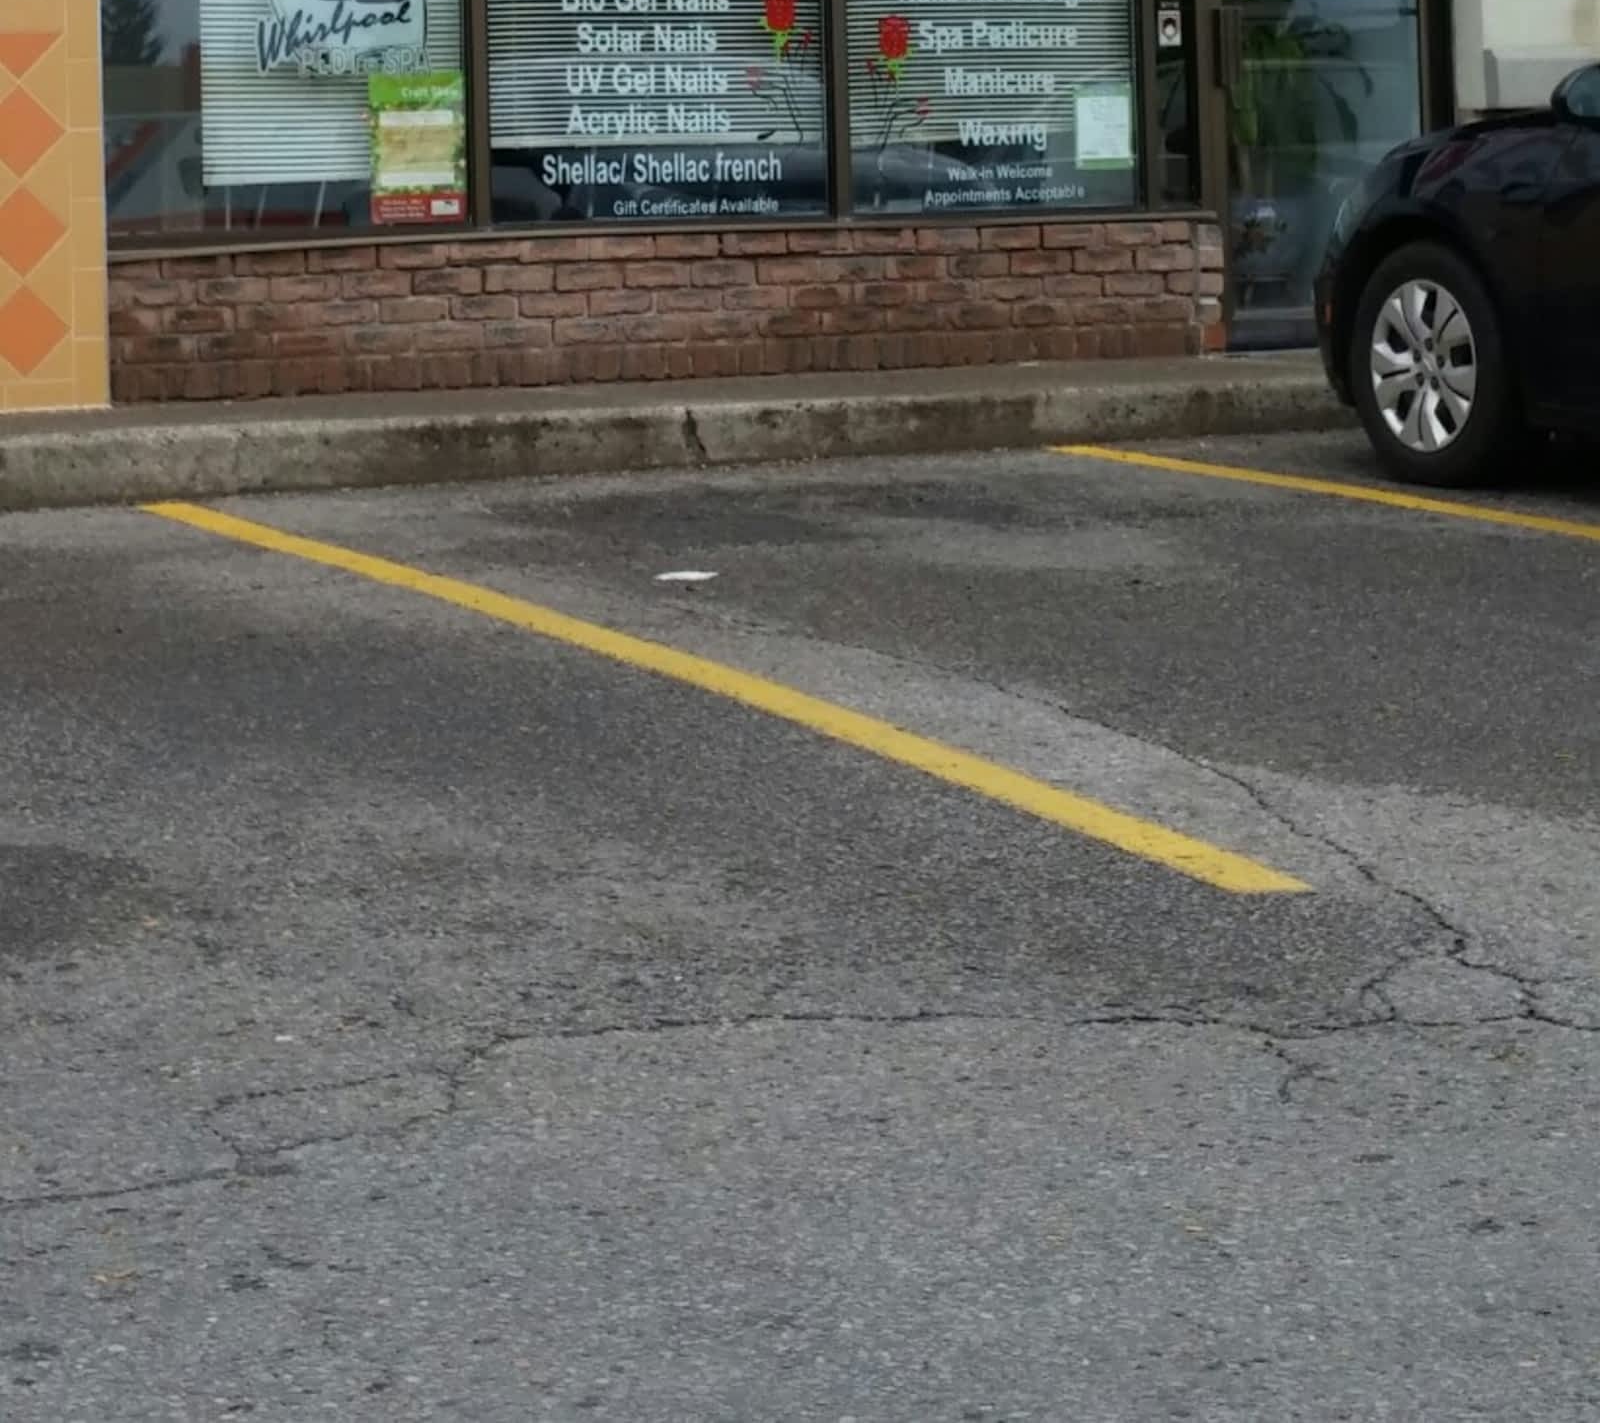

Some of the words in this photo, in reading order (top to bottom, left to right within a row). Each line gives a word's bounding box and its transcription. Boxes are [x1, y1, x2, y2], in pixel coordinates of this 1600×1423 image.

[258, 0, 412, 72] Whirlpool
[577, 23, 643, 53] Solar
[653, 23, 718, 52] Nails
[919, 21, 963, 54] Spa
[972, 21, 1078, 49] Pedicure
[565, 65, 604, 94] UV
[611, 65, 655, 94] Gel
[665, 64, 728, 93] Nails
[944, 66, 1055, 95] Manicure
[567, 105, 659, 138] Acrylic
[667, 105, 731, 134] Nails
[957, 120, 1048, 151] Waxing
[633, 152, 710, 183] Shellac
[715, 151, 782, 182] french
[947, 166, 993, 182] Walk-in
[997, 164, 1053, 180] Welcome
[613, 199, 637, 215] Gift
[641, 198, 716, 216] Certificates
[720, 196, 779, 214] Available
[924, 188, 1012, 208] Appointments
[1016, 184, 1085, 202] Acceptable
